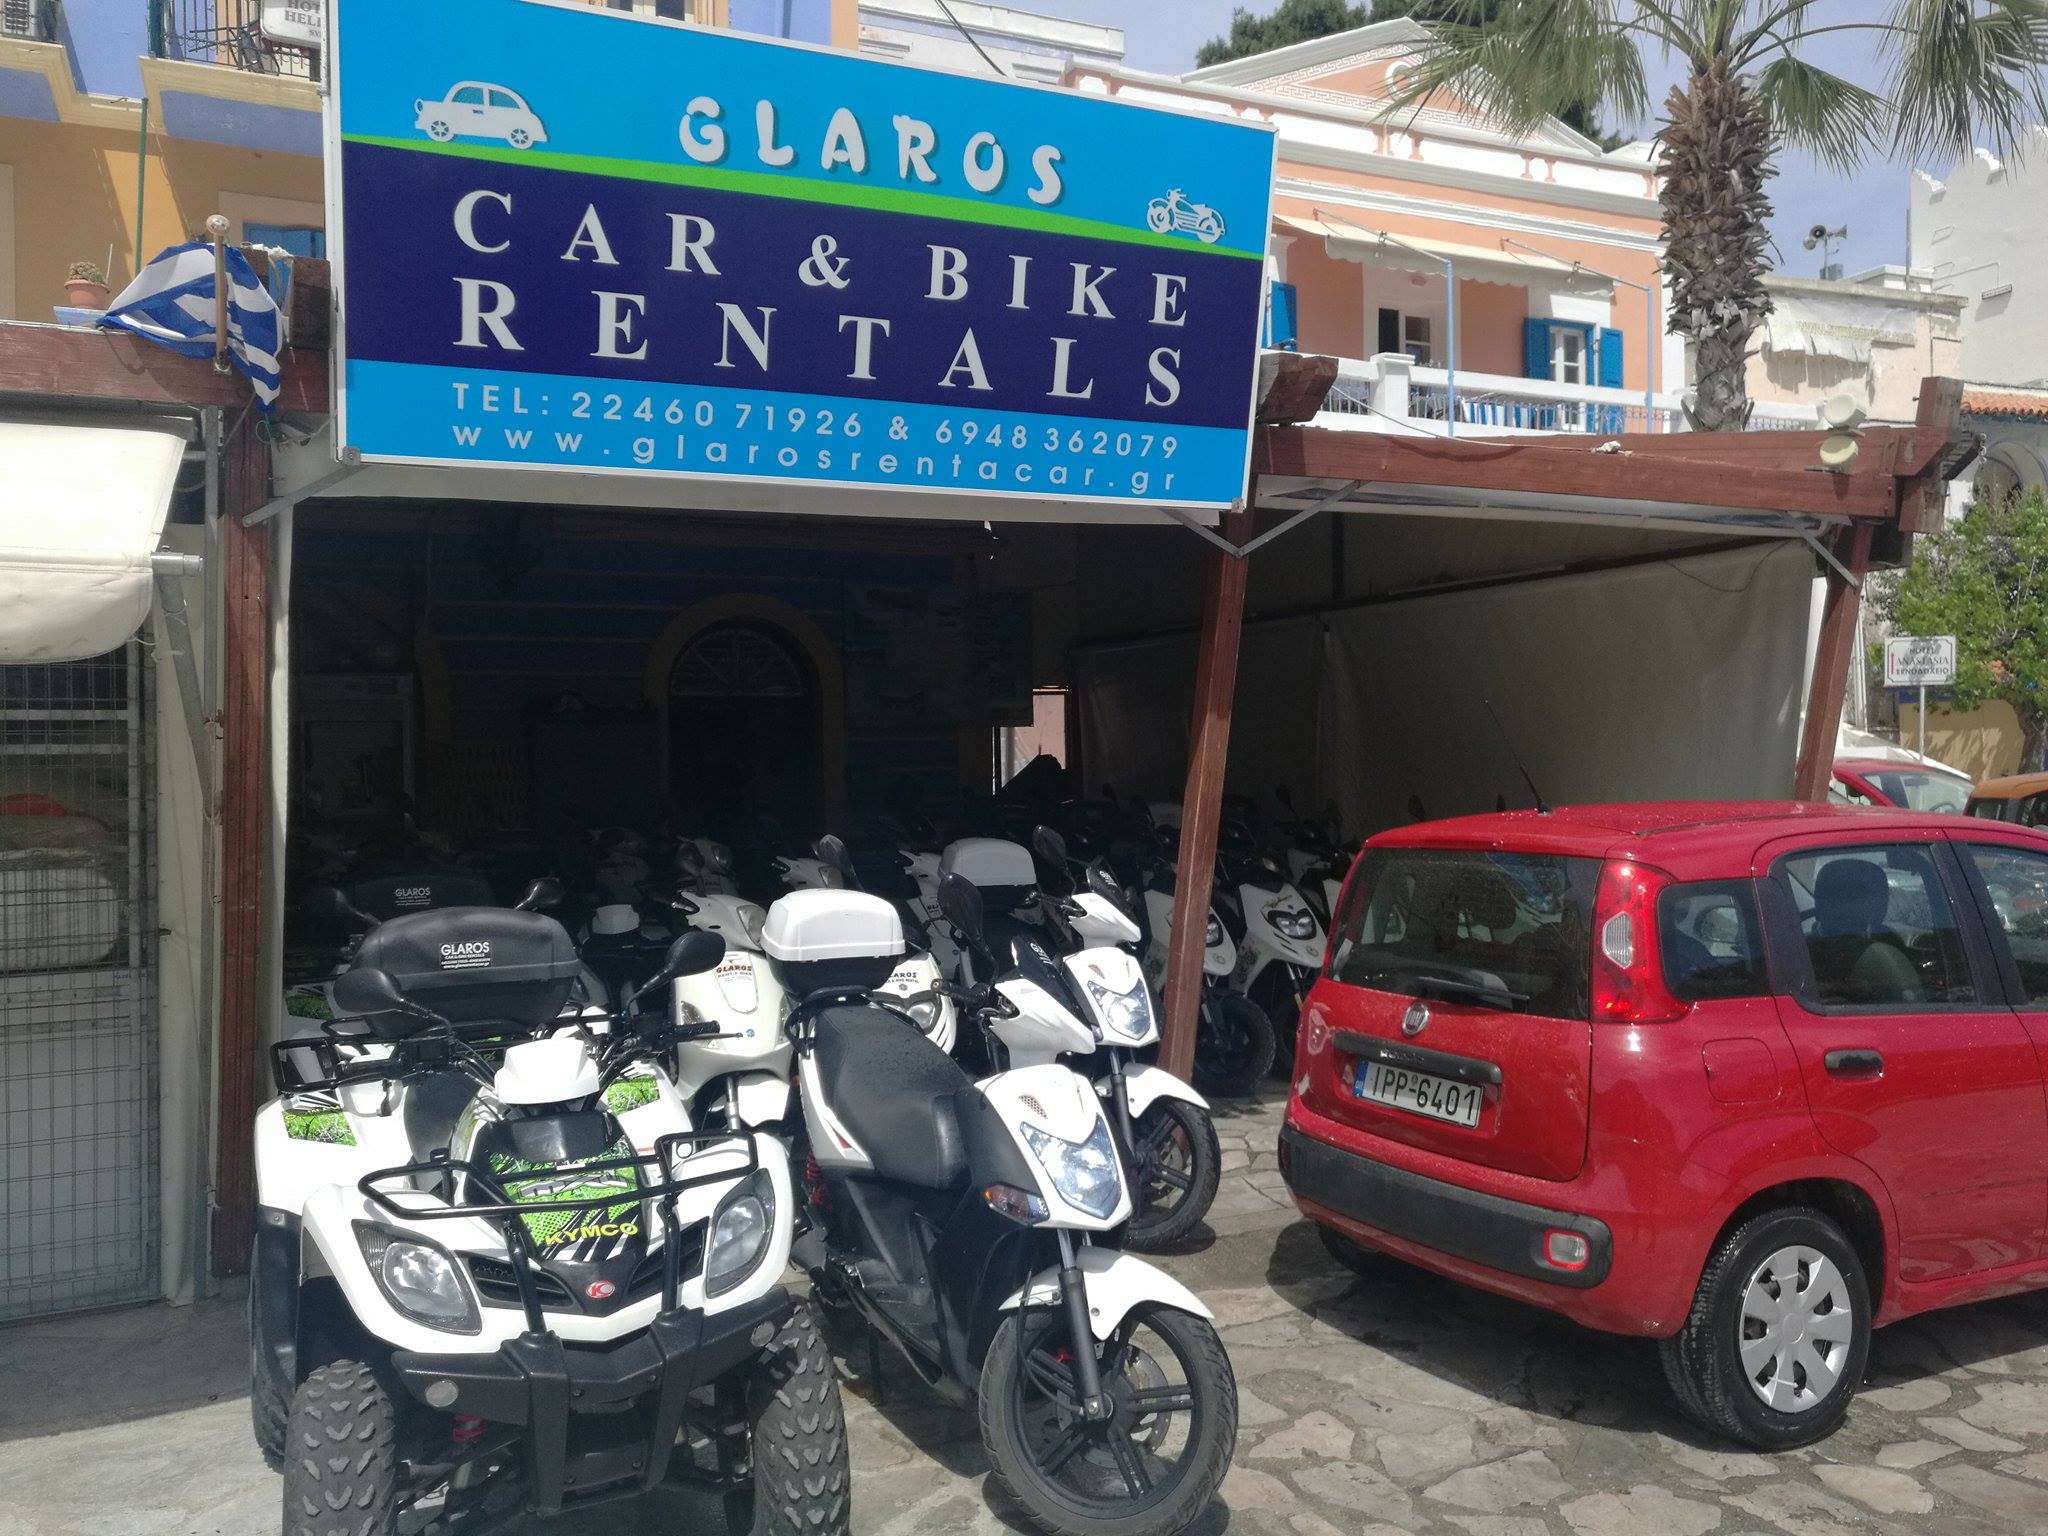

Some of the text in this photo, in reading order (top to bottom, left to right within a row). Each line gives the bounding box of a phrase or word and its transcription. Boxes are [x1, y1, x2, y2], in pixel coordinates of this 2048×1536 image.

[679, 96, 1063, 205] GLAROS
[453, 190, 1187, 327] CAR & BIKE
[452, 277, 1181, 407] RENTALS
[452, 383, 1178, 459] TEL: 22460 71926 & 6948 362079
[452, 425, 1174, 495] www.glarosrentacar.gr
[394, 887, 430, 897] GLAROS
[440, 941, 490, 956] GLAROS
[544, 1222, 639, 1246] KYMCO
